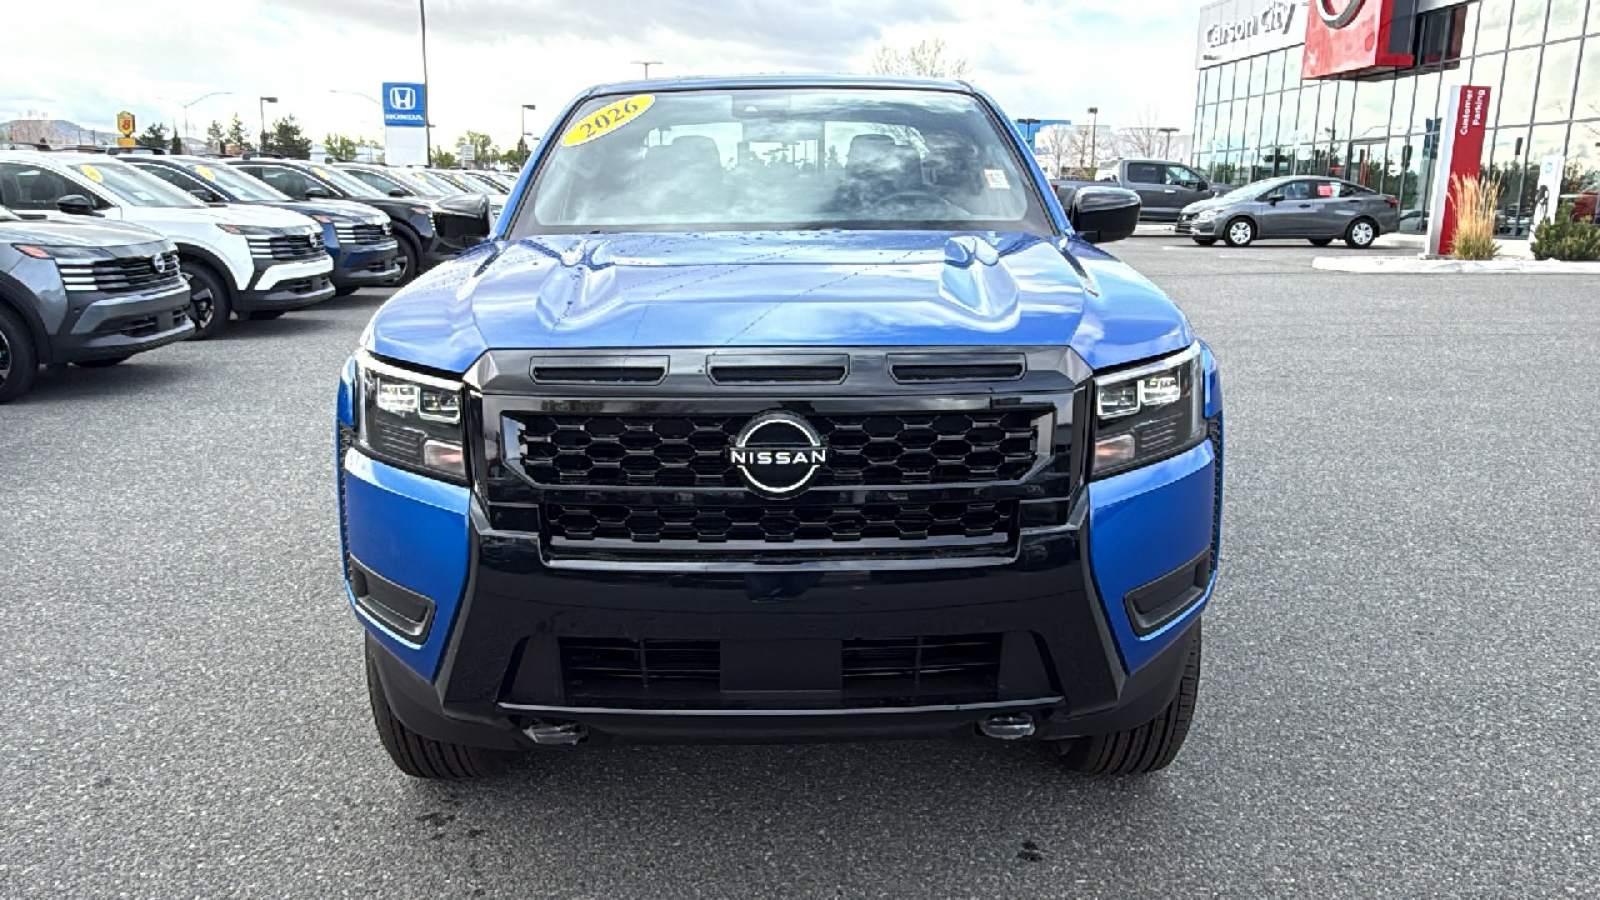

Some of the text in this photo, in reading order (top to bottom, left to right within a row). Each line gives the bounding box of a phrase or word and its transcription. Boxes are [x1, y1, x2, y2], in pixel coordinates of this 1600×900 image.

[1205, 1, 1297, 48] Carson City
[579, 100, 639, 138] 2026
[1460, 89, 1473, 136] Customer
[1472, 89, 1486, 126] Parking
[731, 449, 826, 465] NISSAN
